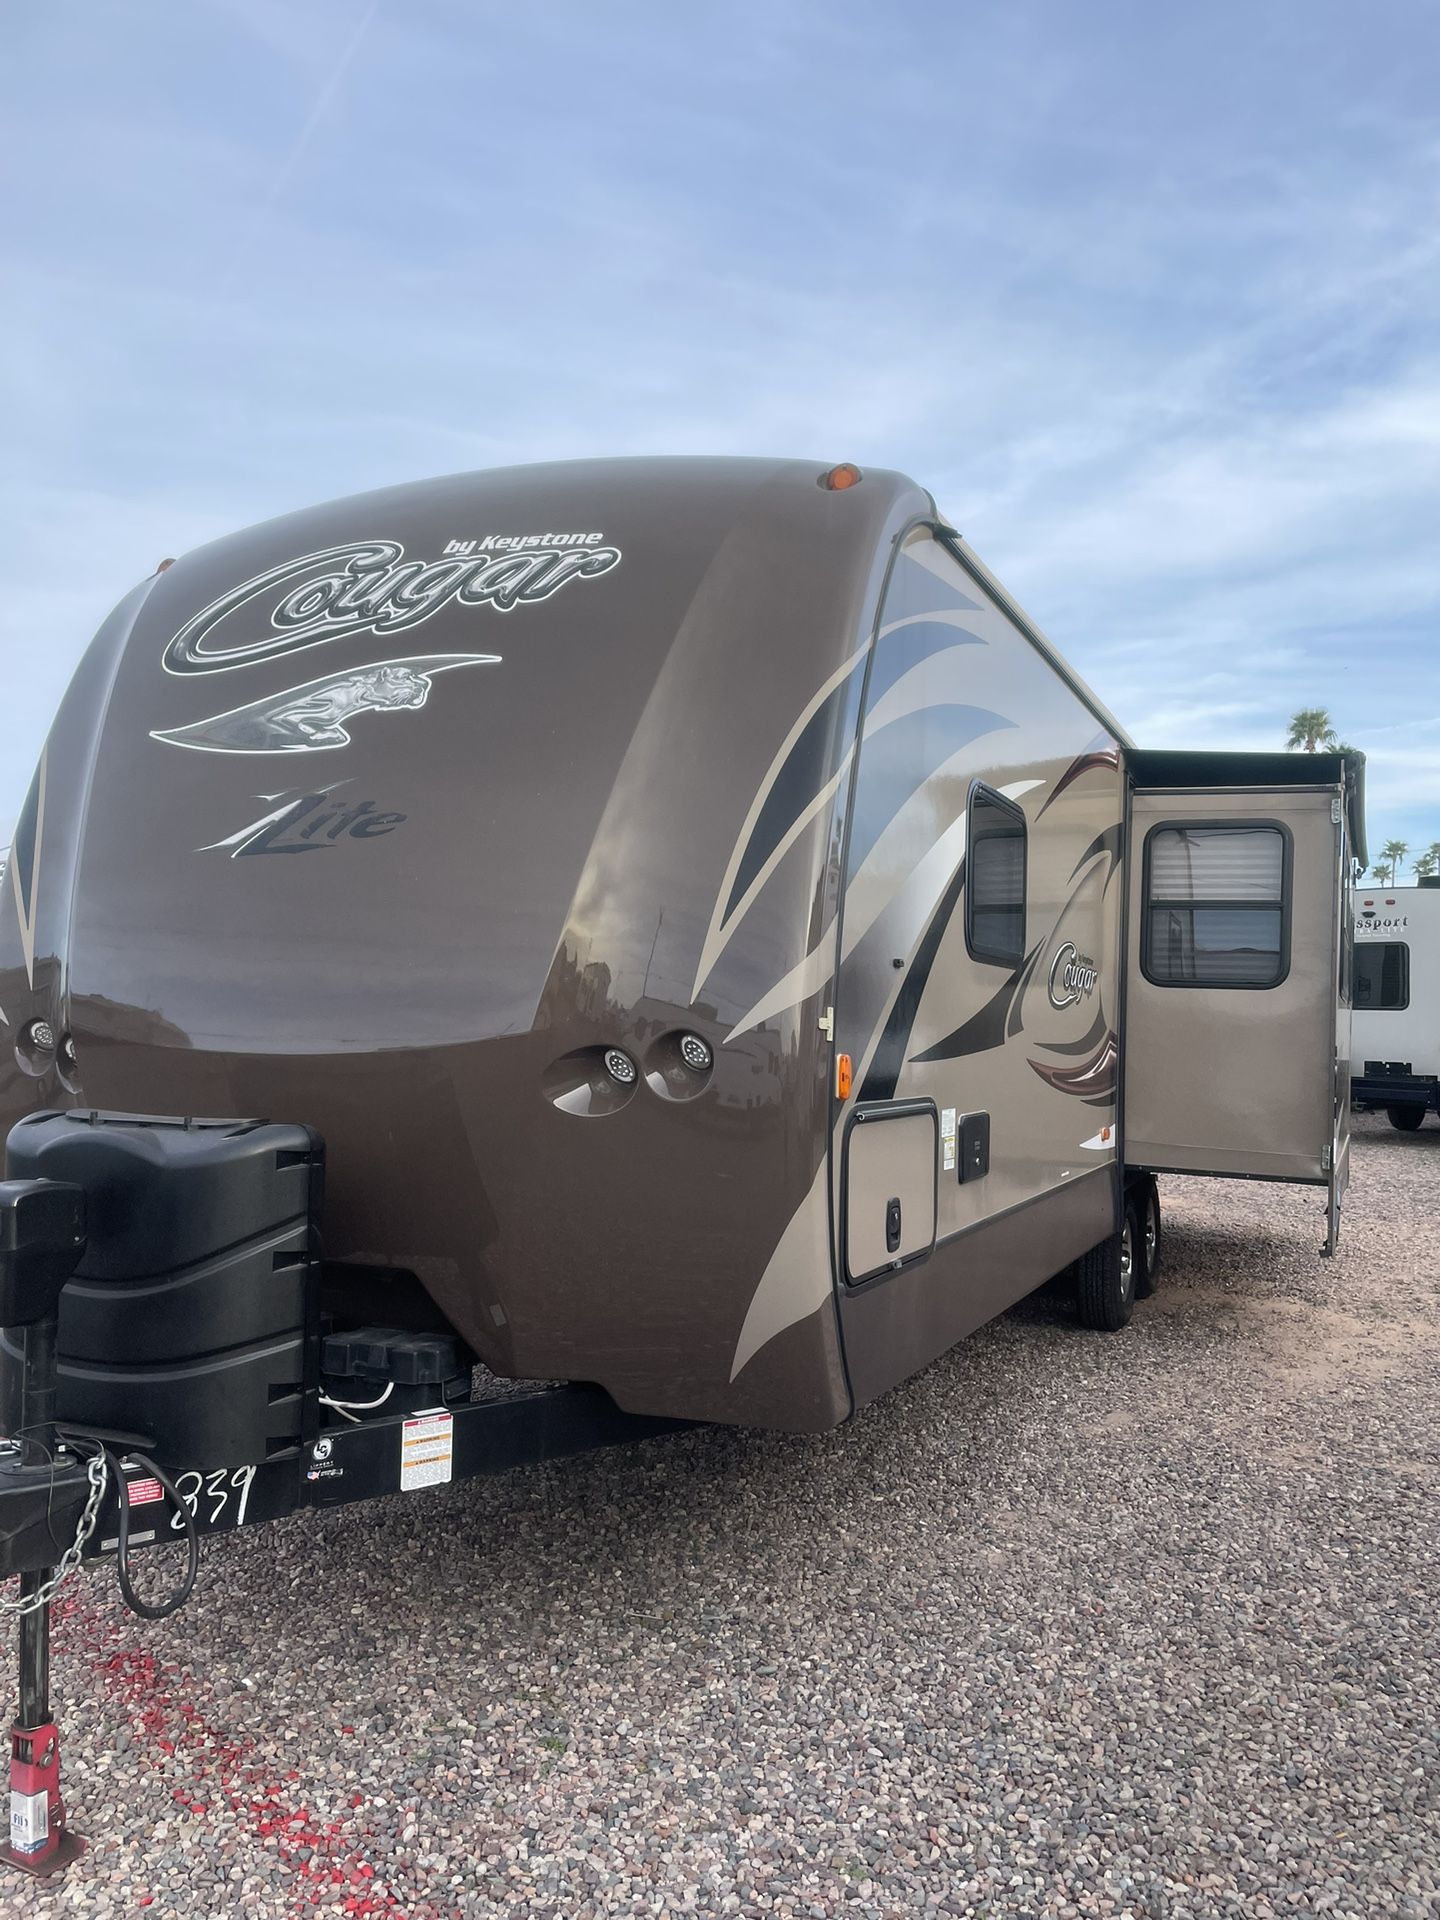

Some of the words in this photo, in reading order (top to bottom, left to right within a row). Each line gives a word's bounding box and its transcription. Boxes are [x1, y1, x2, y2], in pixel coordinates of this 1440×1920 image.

[442, 539, 477, 556] by
[478, 533, 604, 552] Keystone
[162, 540, 622, 676] Cougar
[1356, 915, 1409, 930] ssport
[1048, 941, 1098, 1010] Cougar
